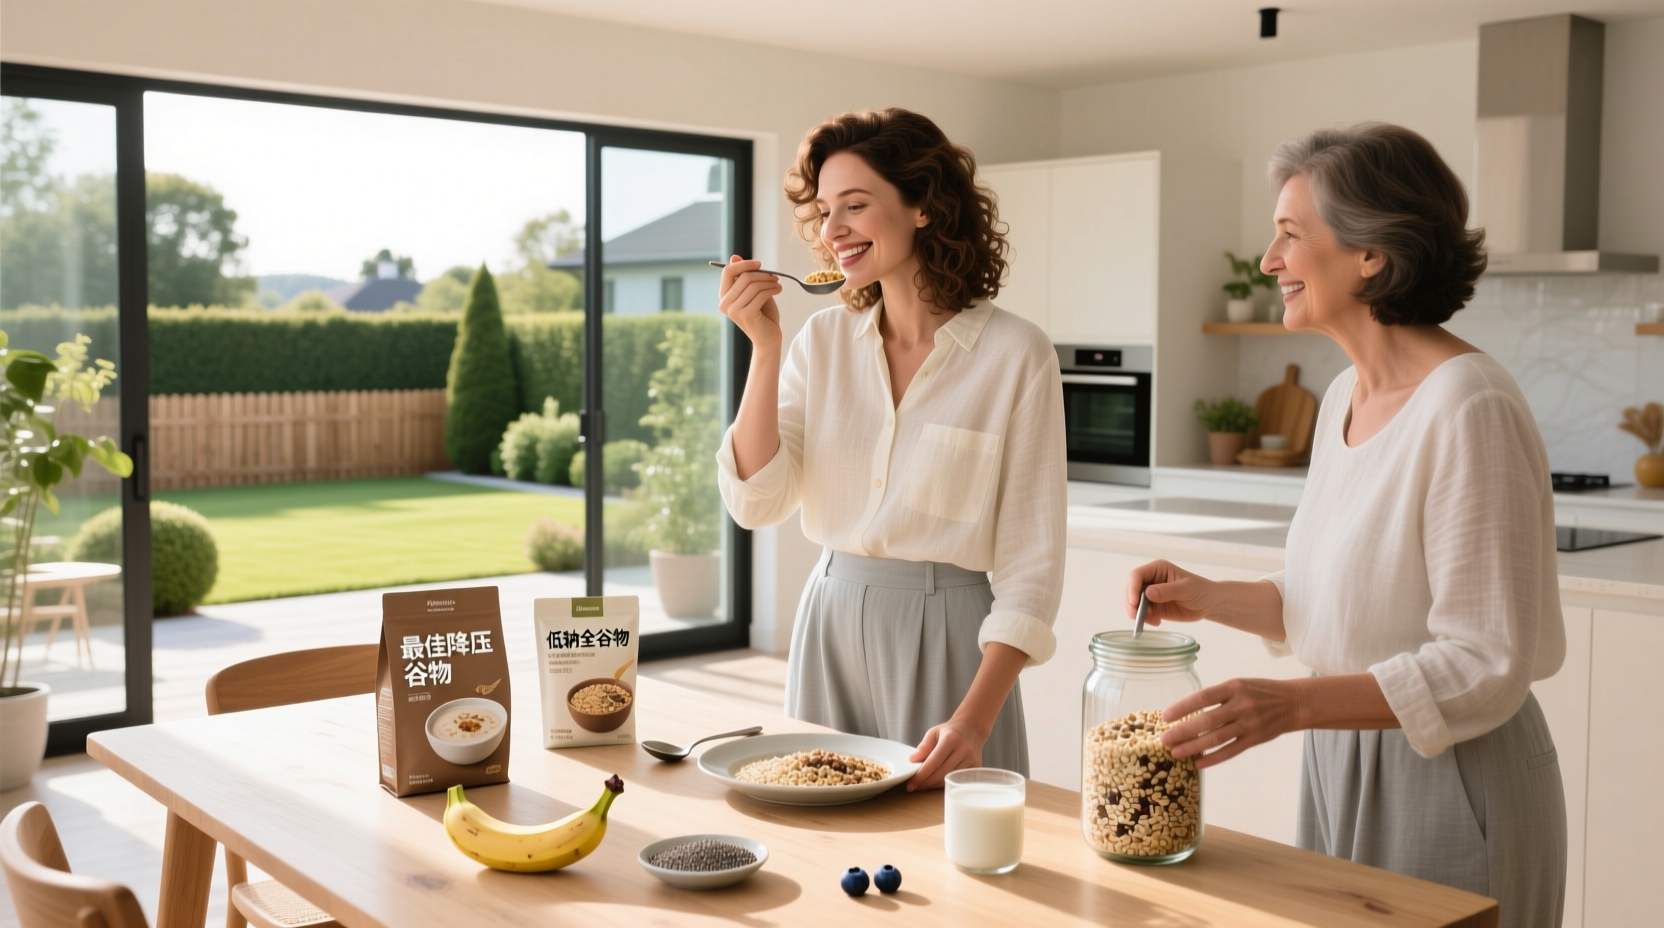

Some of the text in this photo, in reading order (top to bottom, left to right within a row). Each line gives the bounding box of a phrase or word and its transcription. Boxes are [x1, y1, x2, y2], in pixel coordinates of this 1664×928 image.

[400, 630, 494, 660] 最佳降压
[404, 660, 452, 688] 谷物
